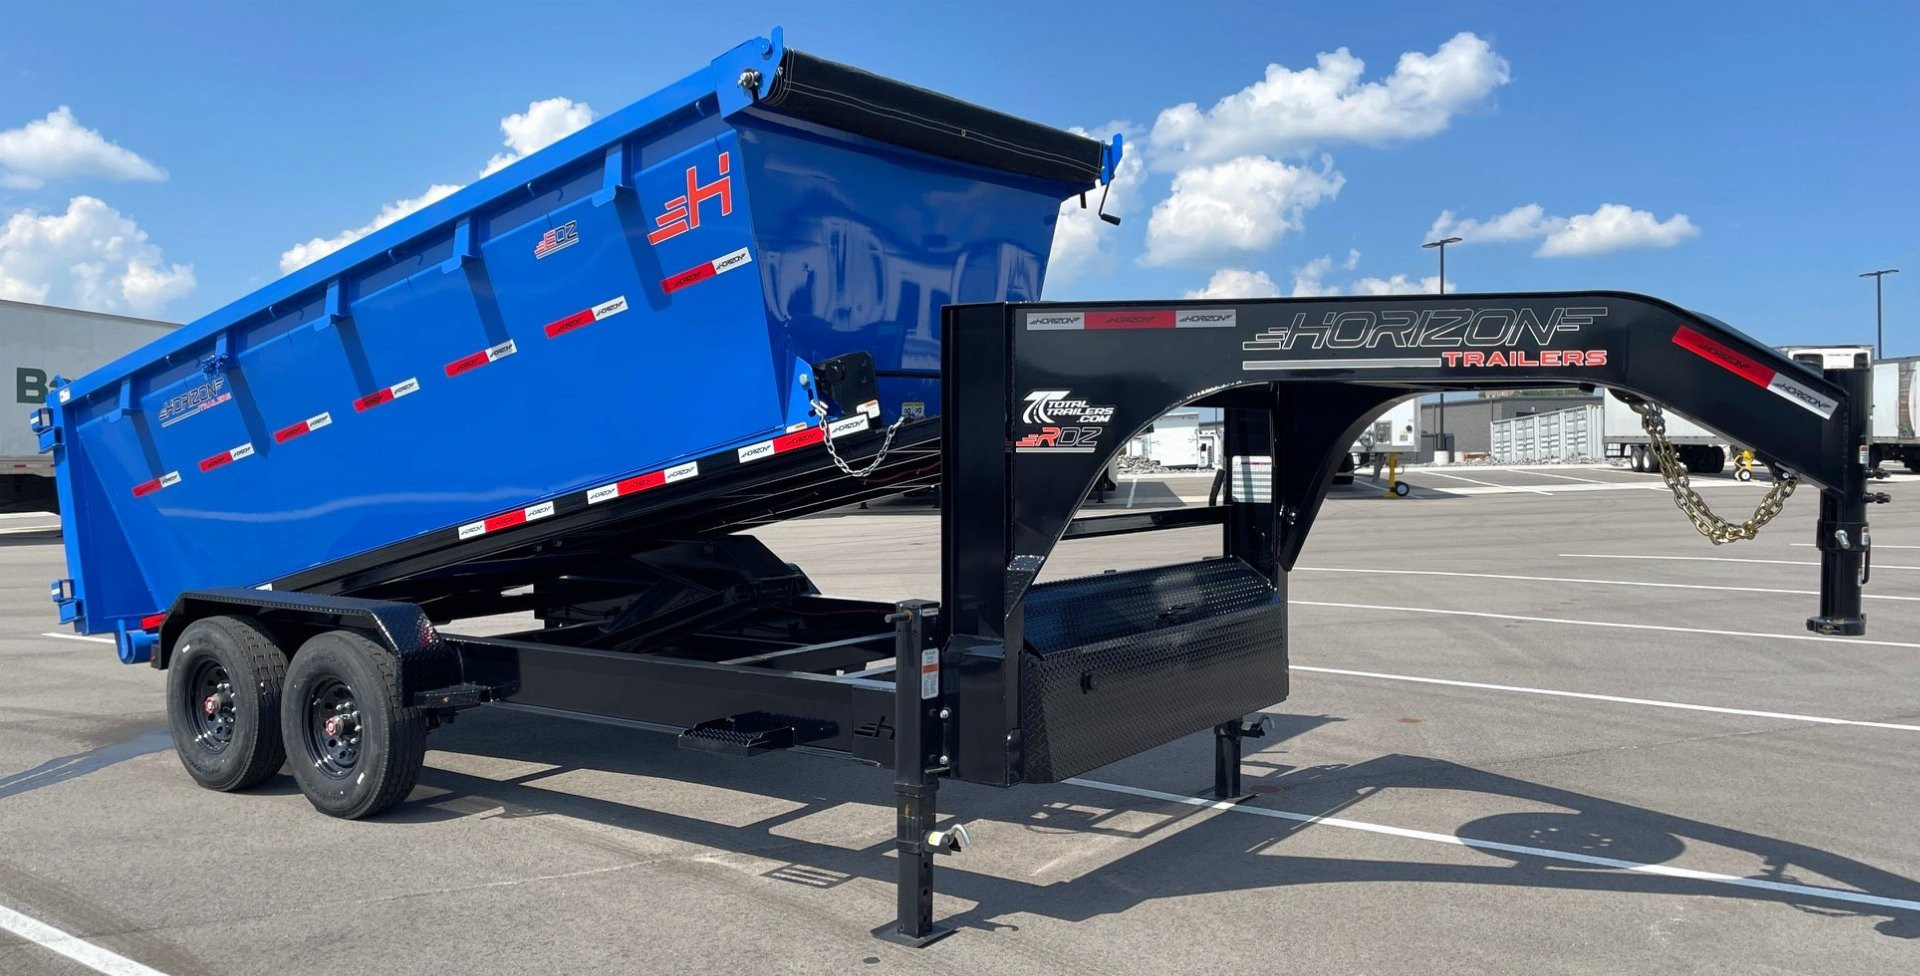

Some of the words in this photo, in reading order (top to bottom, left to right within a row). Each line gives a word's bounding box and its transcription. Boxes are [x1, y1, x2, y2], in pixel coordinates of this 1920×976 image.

[717, 254, 746, 271] HORIZON
[1031, 317, 1081, 325] HORIZON
[1180, 314, 1232, 323] HORIZON
[1282, 307, 1566, 350] HORIZON
[1442, 350, 1608, 368] TRAILERS
[162, 379, 221, 418] HORIZON
[1774, 383, 1832, 408] HORIZON
[1047, 400, 1090, 408] TOTAL
[1046, 407, 1115, 416] TRAILERS
[832, 419, 865, 433] HORIZON
[1076, 415, 1111, 423] .COM
[1033, 427, 1102, 446] RDZ
[741, 445, 771, 458] HORIZON
